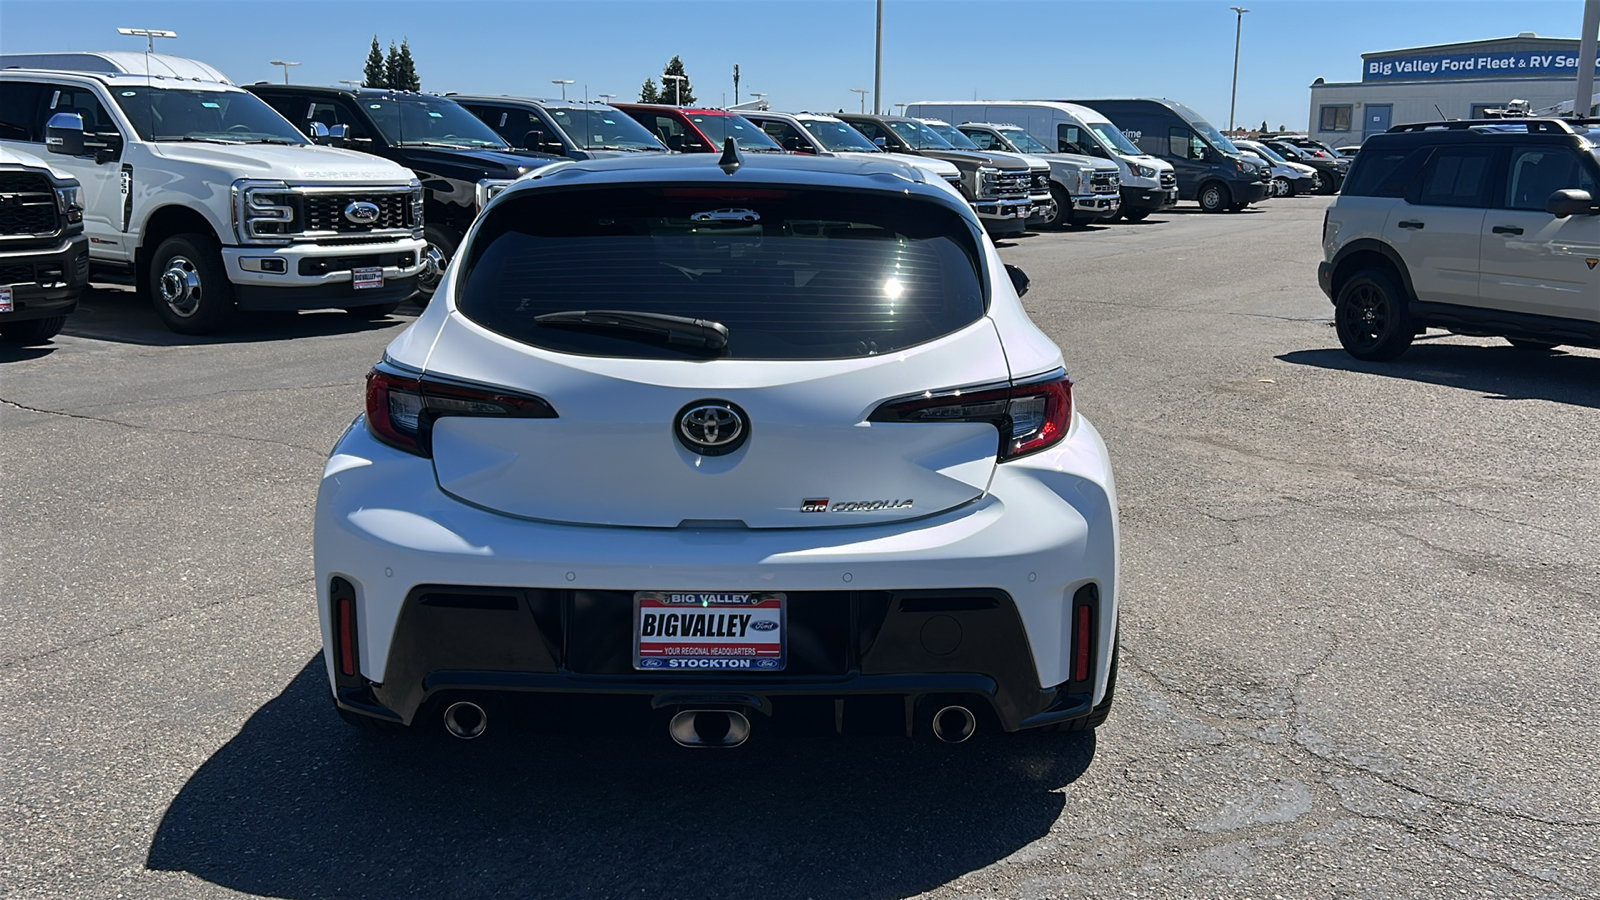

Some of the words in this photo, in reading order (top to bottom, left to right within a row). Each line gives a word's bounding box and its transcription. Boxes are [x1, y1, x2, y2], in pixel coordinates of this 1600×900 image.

[1369, 62, 1392, 75] Big
[1395, 60, 1438, 73] Valley
[1441, 58, 1474, 71] Ford
[1477, 56, 1515, 69] Fleet
[1518, 59, 1526, 68] &
[1530, 55, 1553, 68] RV
[801, 504, 826, 512] GR
[831, 499, 914, 512] COROLLA
[671, 594, 696, 604] BIG
[700, 594, 749, 604] VALLEY
[641, 613, 752, 638] BIGVALLEY
[664, 647, 680, 655] YOUR
[681, 647, 710, 655] REGIONAL
[710, 647, 756, 656] HEADQUARTERS
[669, 659, 751, 668] STOCKTON
